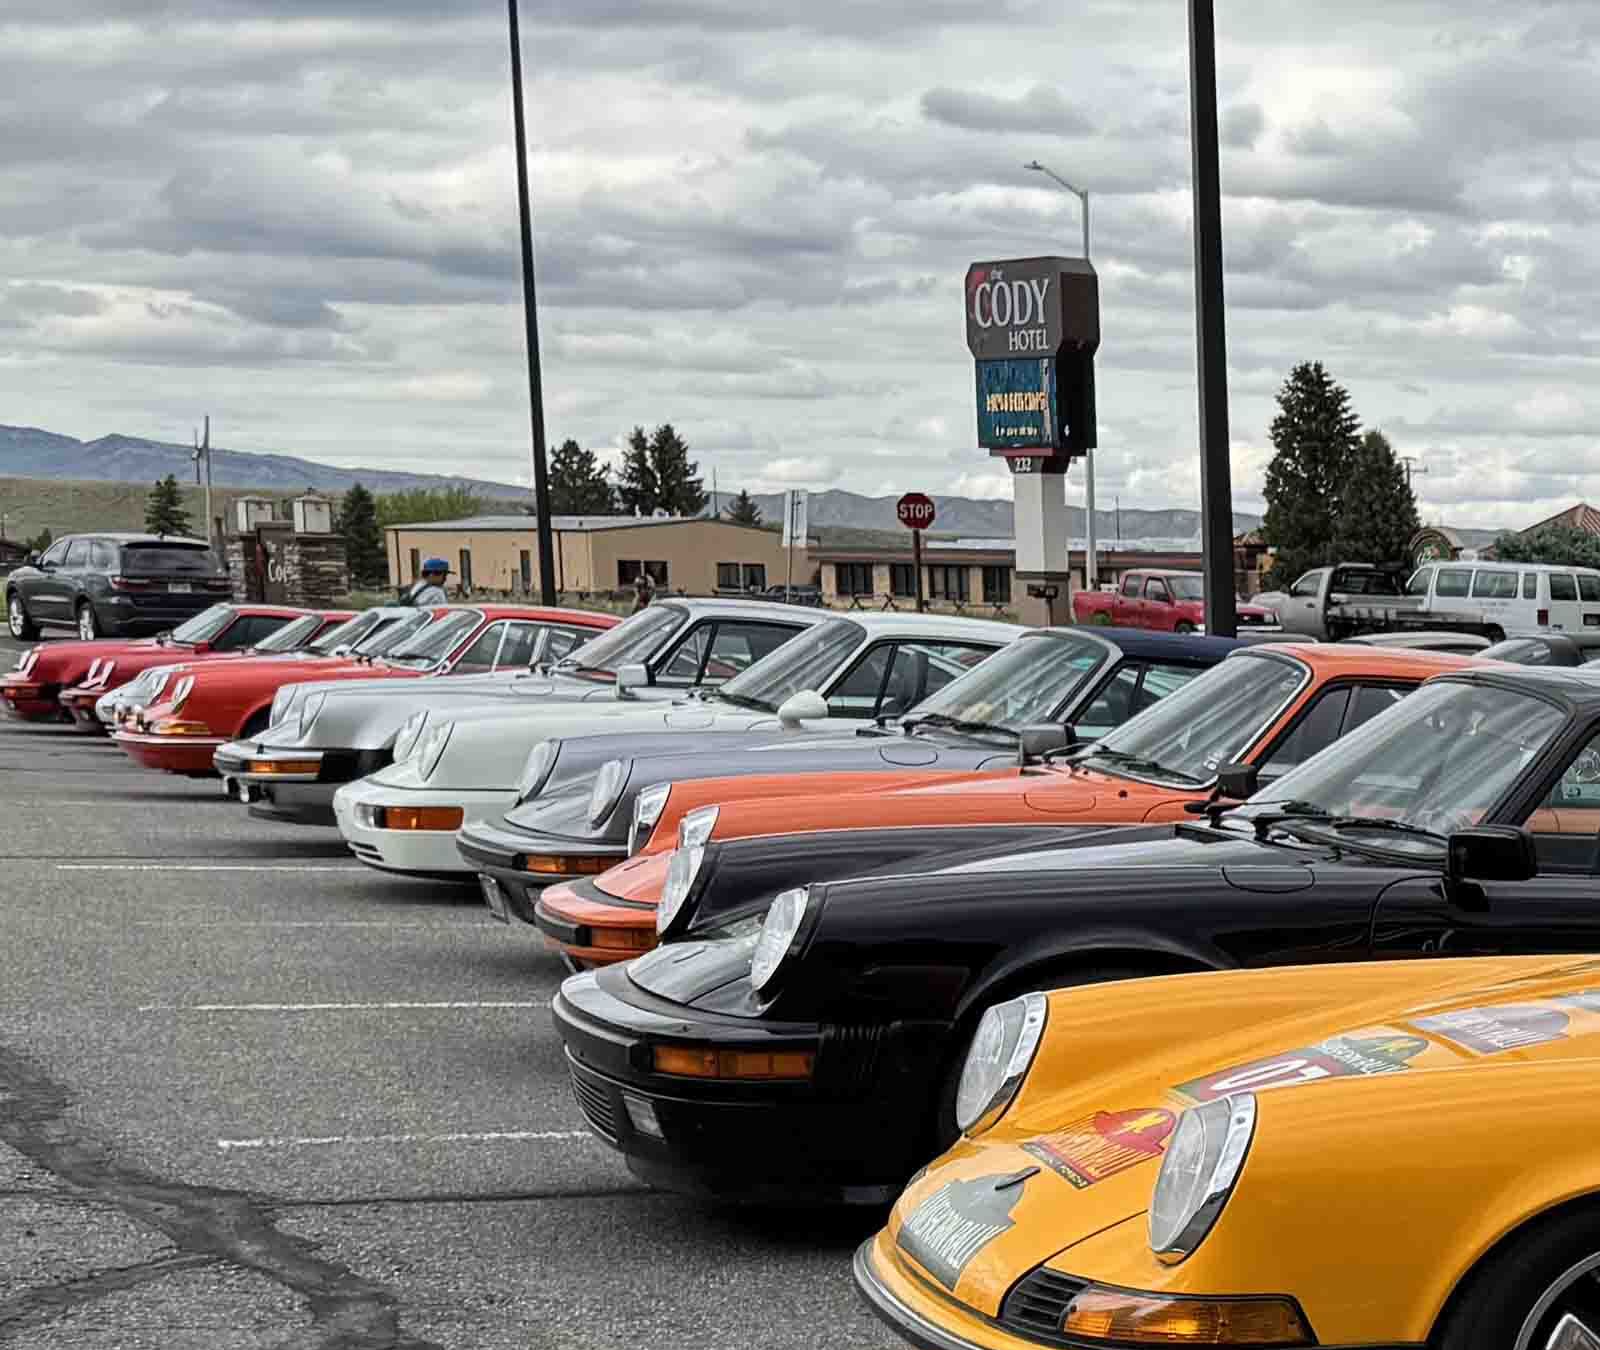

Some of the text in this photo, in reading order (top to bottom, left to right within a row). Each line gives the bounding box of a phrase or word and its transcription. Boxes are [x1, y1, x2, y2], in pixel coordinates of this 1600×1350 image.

[975, 278, 1049, 329] CODY
[1008, 328, 1049, 351] HOTEL
[899, 503, 934, 519] STOP
